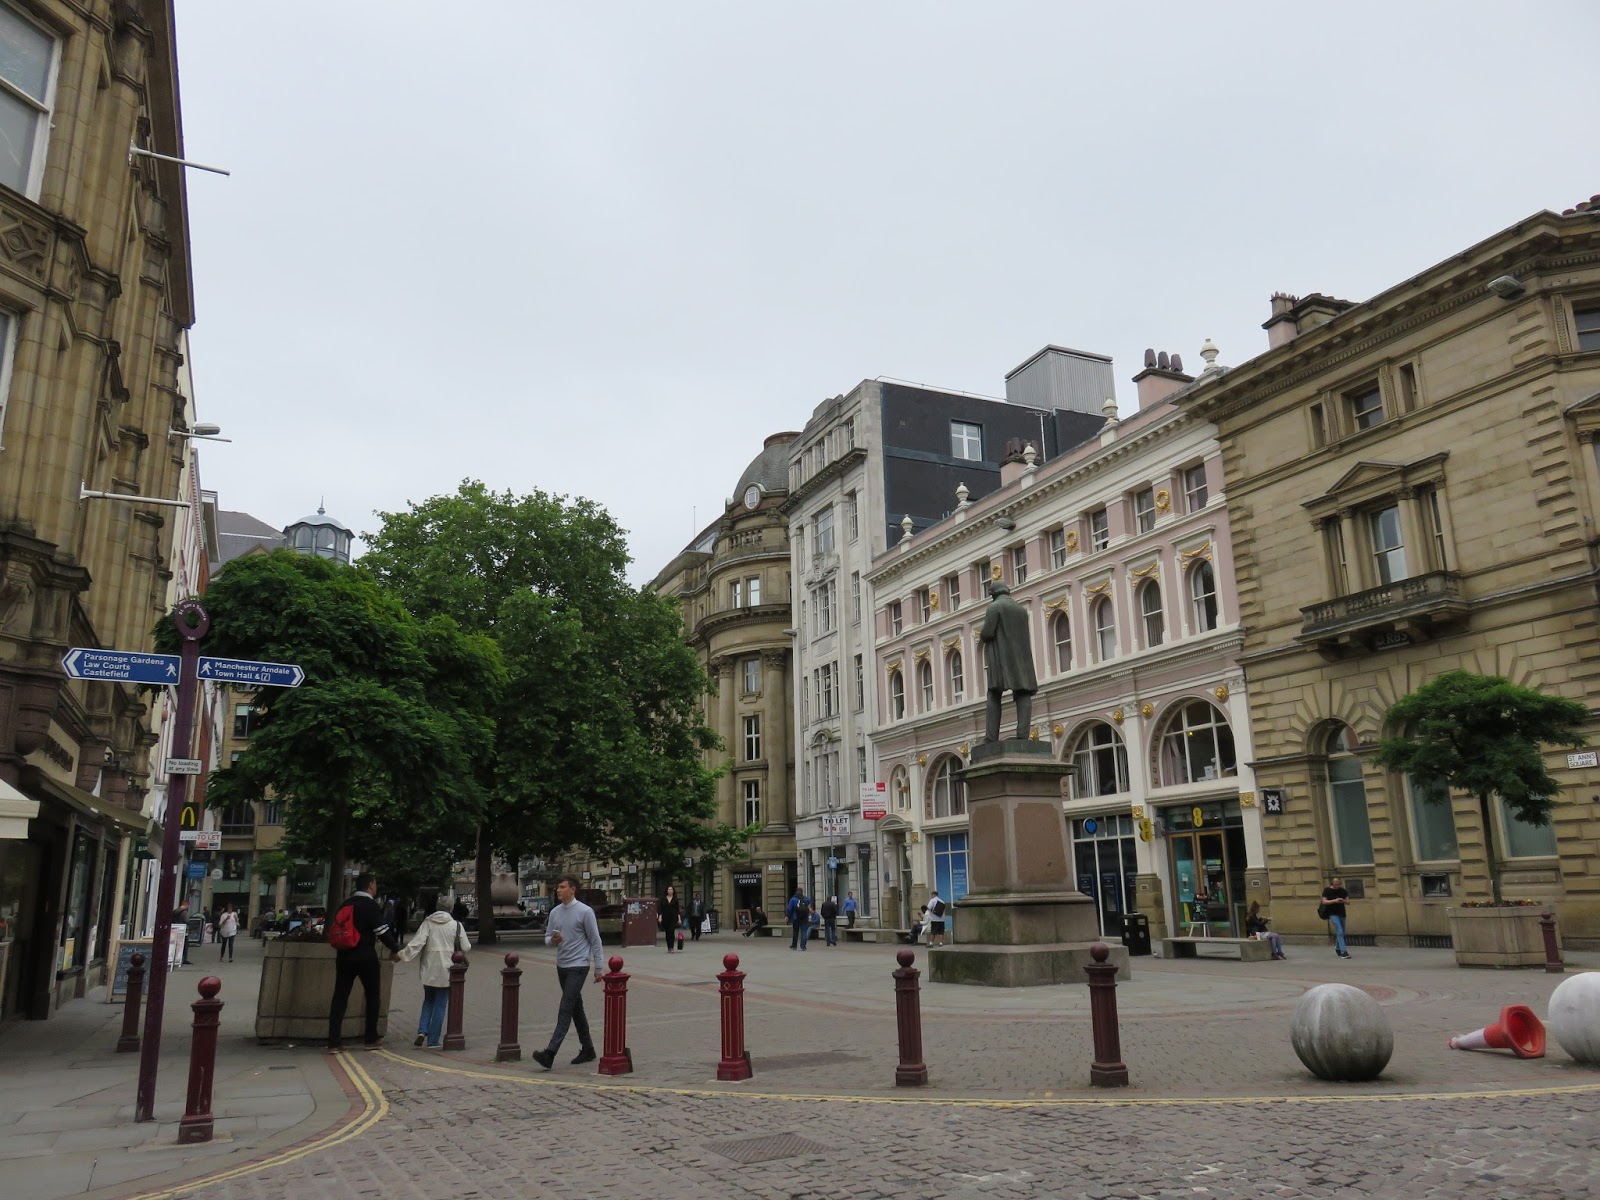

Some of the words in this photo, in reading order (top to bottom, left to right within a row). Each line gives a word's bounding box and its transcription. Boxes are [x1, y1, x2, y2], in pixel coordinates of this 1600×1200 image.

[1386, 632, 1408, 644] RBS
[84, 653, 128, 663] Parsonage
[130, 656, 164, 665] Gardens
[103, 662, 131, 670] Courts
[214, 661, 259, 672] Manchester
[261, 666, 290, 674] Arndale
[83, 668, 129, 678] Castlefield
[214, 669, 234, 677] Town
[236, 671, 253, 679] Hall
